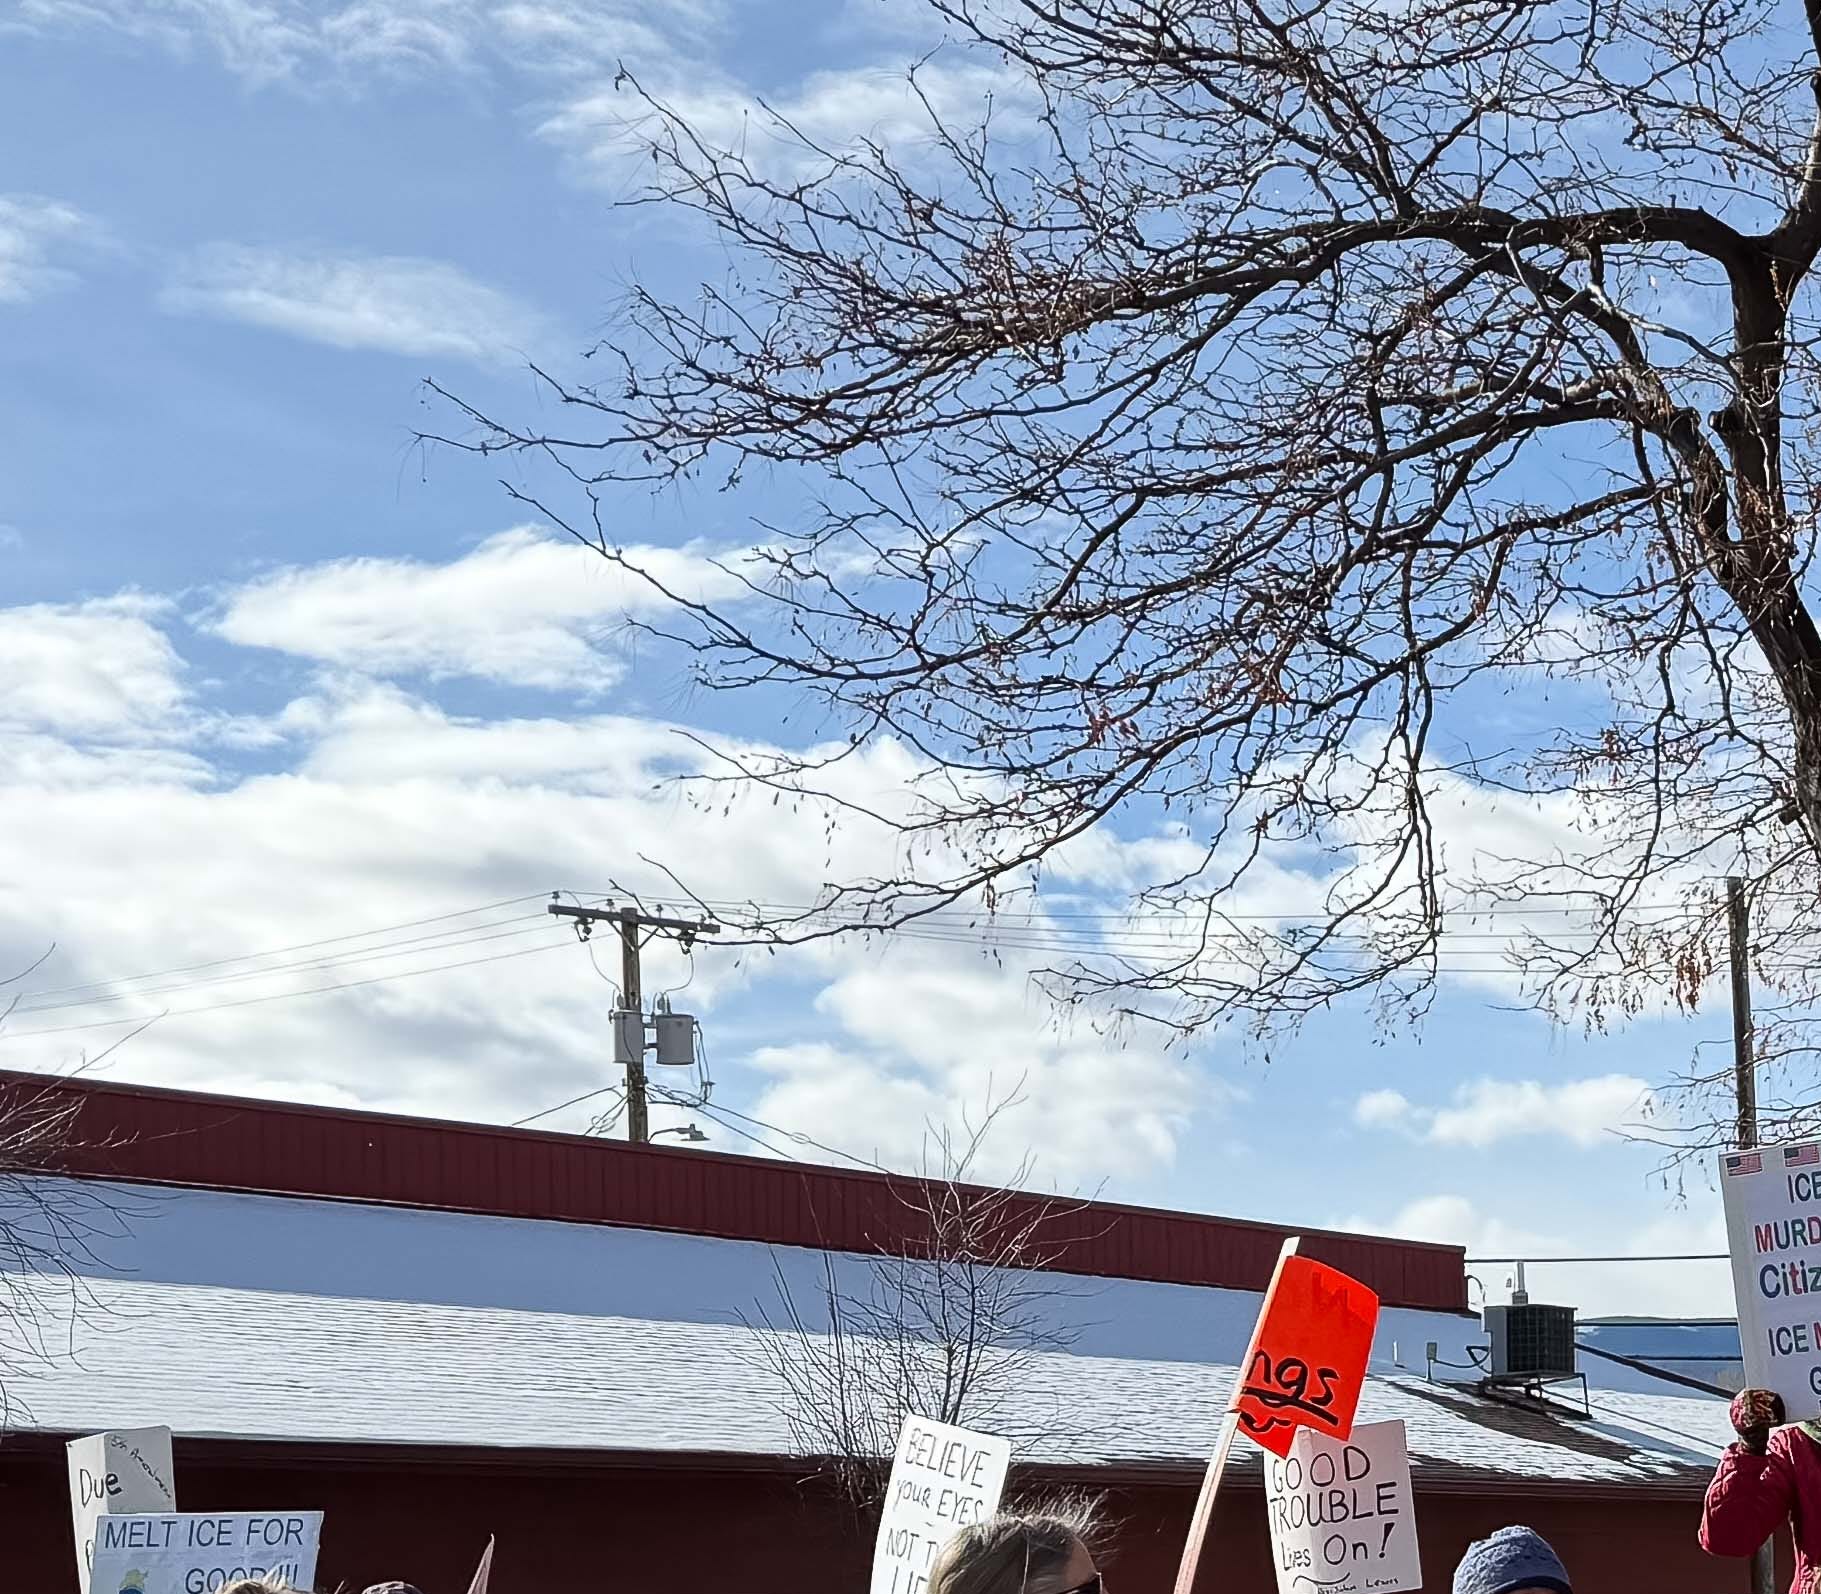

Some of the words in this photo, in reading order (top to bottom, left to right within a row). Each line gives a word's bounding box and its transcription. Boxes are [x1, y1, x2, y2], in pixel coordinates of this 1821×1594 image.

[1768, 1324, 1809, 1357] ICE
[1247, 1349, 1340, 1406] ngs
[906, 1427, 991, 1488] BELIEVE
[1273, 1445, 1371, 1493] GOOD
[80, 1468, 122, 1508] Due
[936, 1488, 984, 1525] EYES
[1269, 1481, 1399, 1536] TROUBLE
[105, 1520, 177, 1549] MELT
[188, 1519, 233, 1547] ICE
[246, 1518, 304, 1546] FOR
[886, 1528, 920, 1561] NOT
